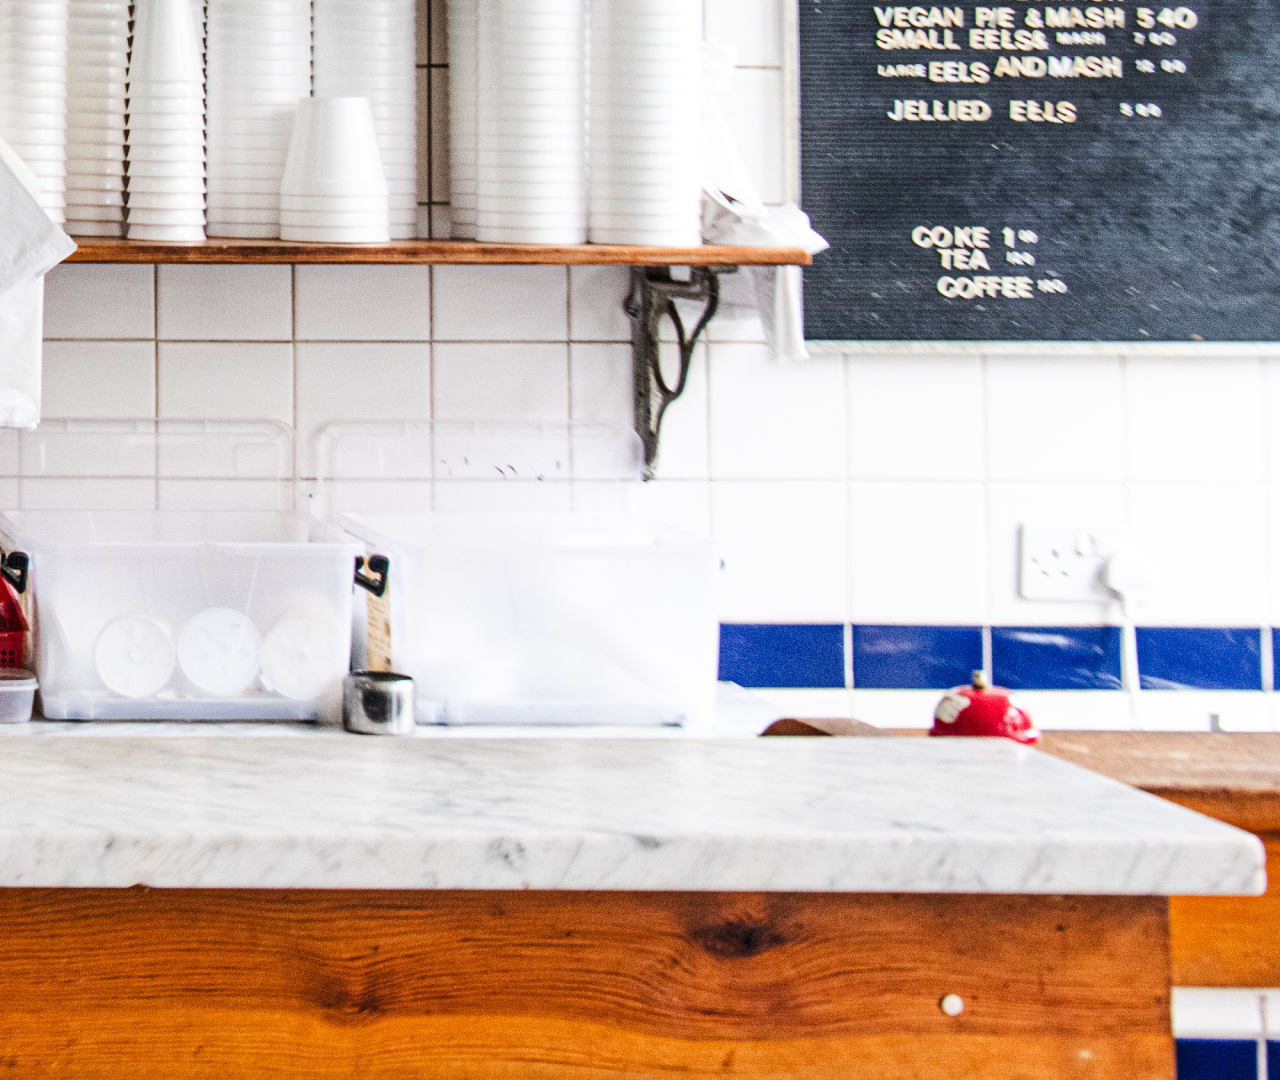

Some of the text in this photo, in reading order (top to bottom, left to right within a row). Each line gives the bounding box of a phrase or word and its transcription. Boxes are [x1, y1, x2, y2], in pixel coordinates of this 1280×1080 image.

[872, 6, 965, 28] VEGAN
[974, 6, 1016, 29] PIE
[875, 28, 962, 50] SMALL
[1055, 31, 1107, 46] MASH
[876, 63, 927, 78] LARGE
[928, 60, 991, 85] EELS
[886, 99, 993, 122] JELLIED
[1009, 99, 1078, 124] EELS
[911, 225, 990, 249] COKE
[936, 248, 990, 271] TEA
[936, 275, 1034, 300] COFFEE
